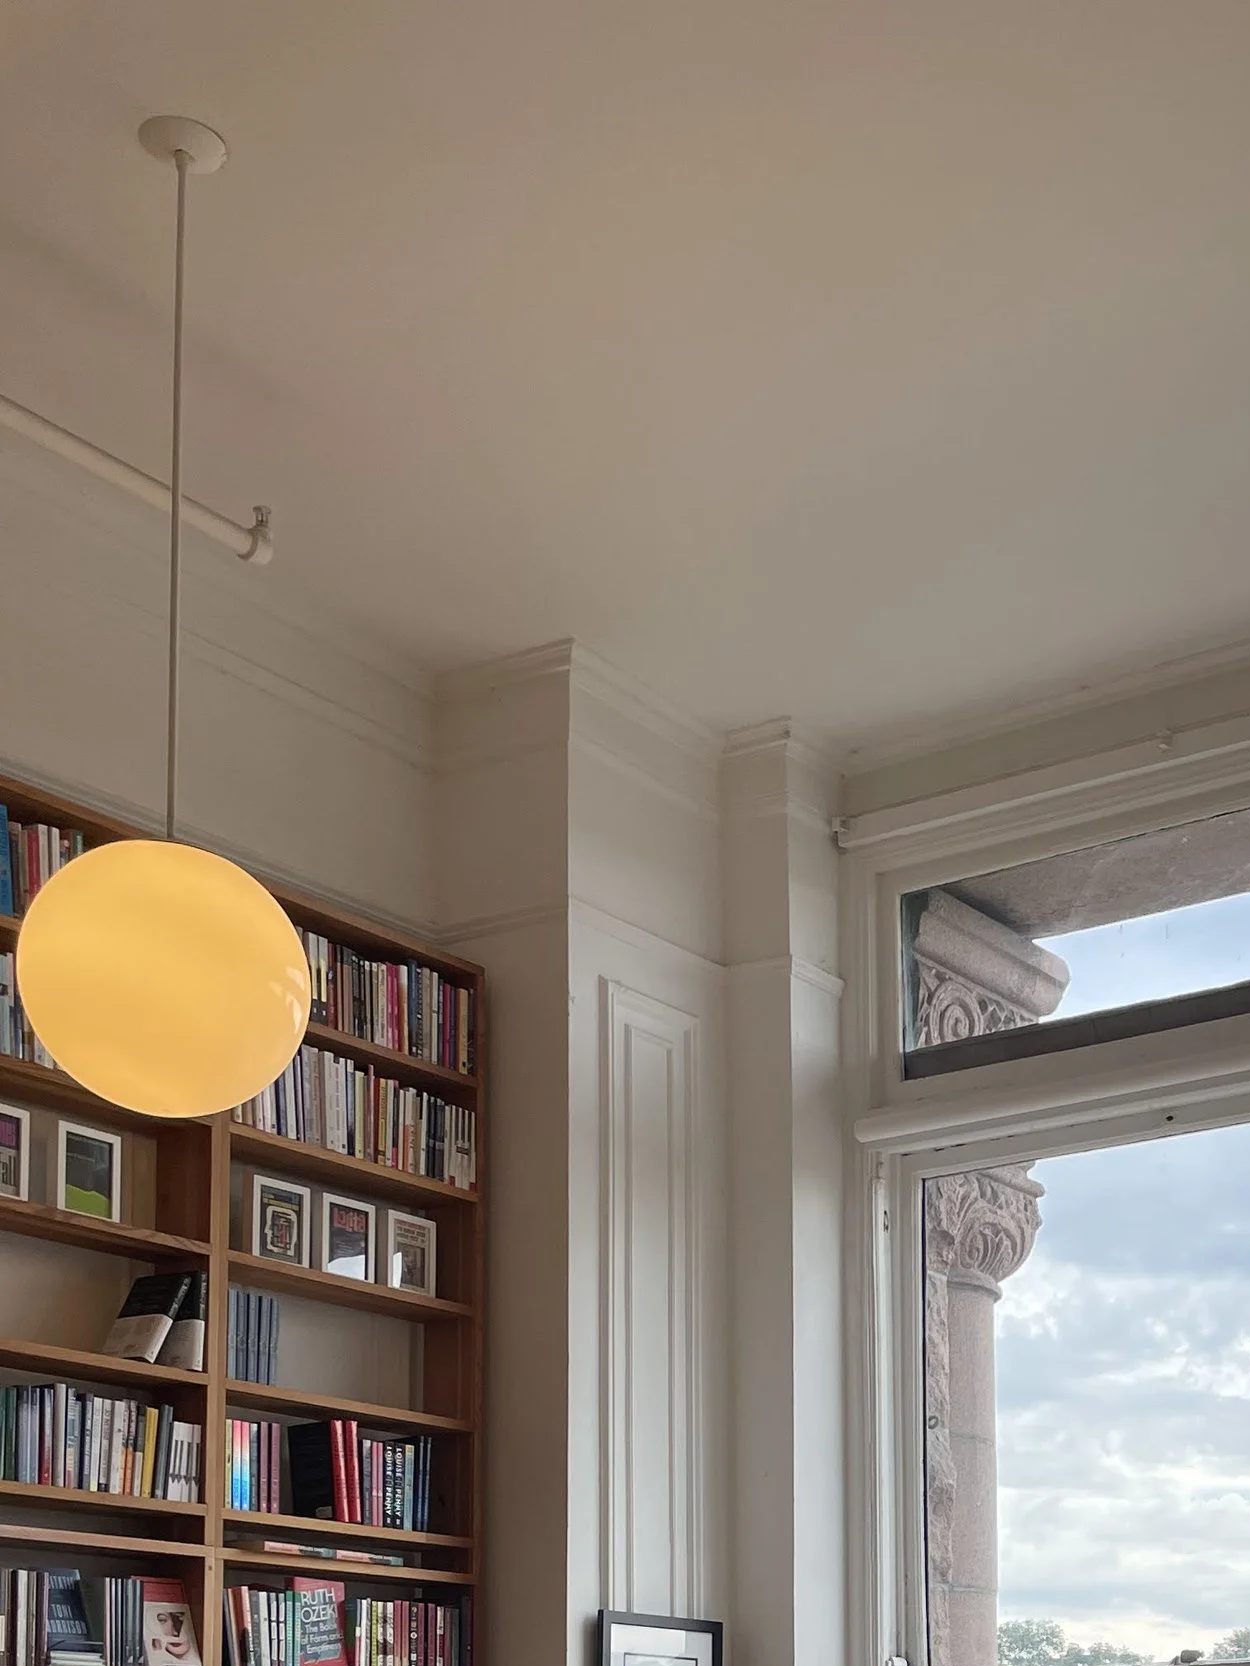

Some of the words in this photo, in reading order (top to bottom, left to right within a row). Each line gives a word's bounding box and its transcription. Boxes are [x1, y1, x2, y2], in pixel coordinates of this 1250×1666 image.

[394, 1488, 402, 1518] PENNY
[300, 1588, 336, 1606] RUTH
[50, 1604, 73, 1618] TONI
[301, 1604, 338, 1623] OZEKI
[304, 1624, 318, 1634] The
